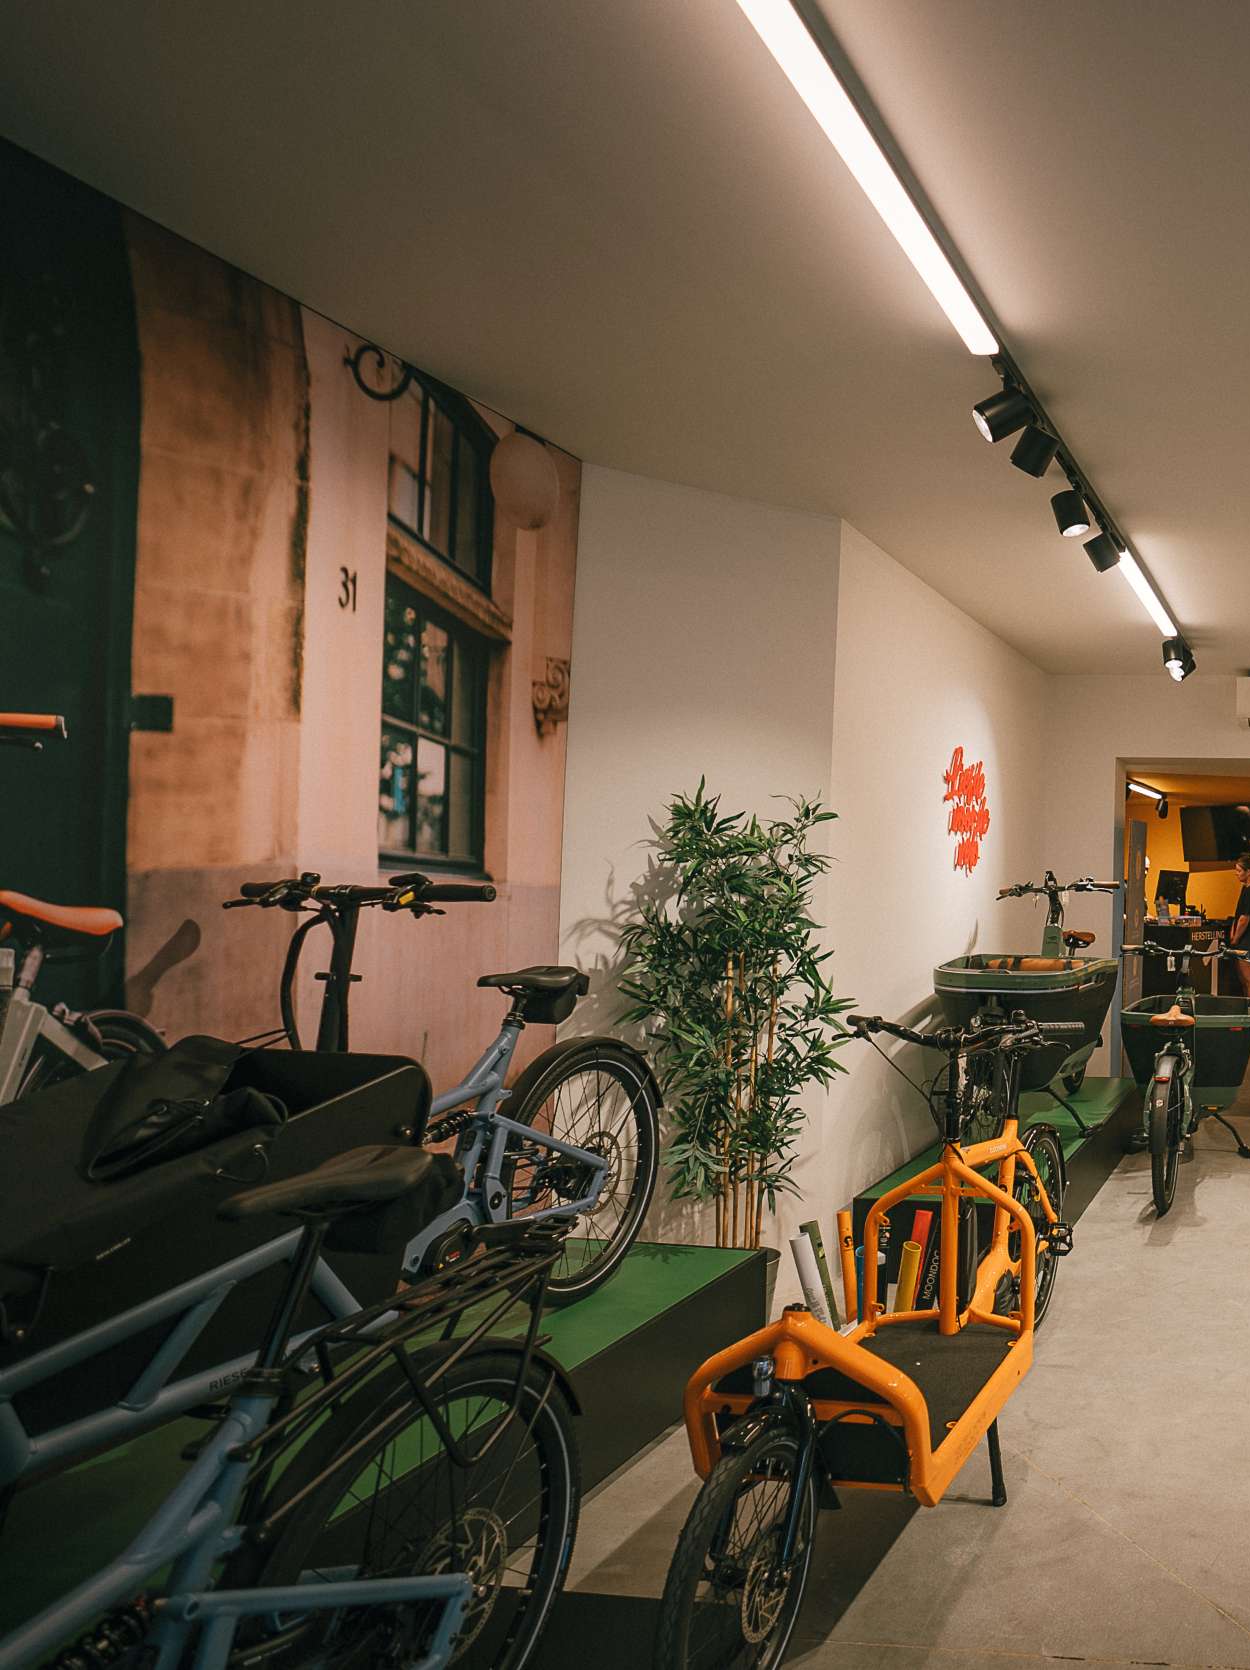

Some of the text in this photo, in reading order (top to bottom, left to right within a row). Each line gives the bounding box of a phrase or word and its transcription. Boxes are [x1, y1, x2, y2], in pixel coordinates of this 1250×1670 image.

[338, 566, 357, 613] 31
[1191, 930, 1225, 941] HERSTELLING
[1202, 939, 1219, 997] 1
